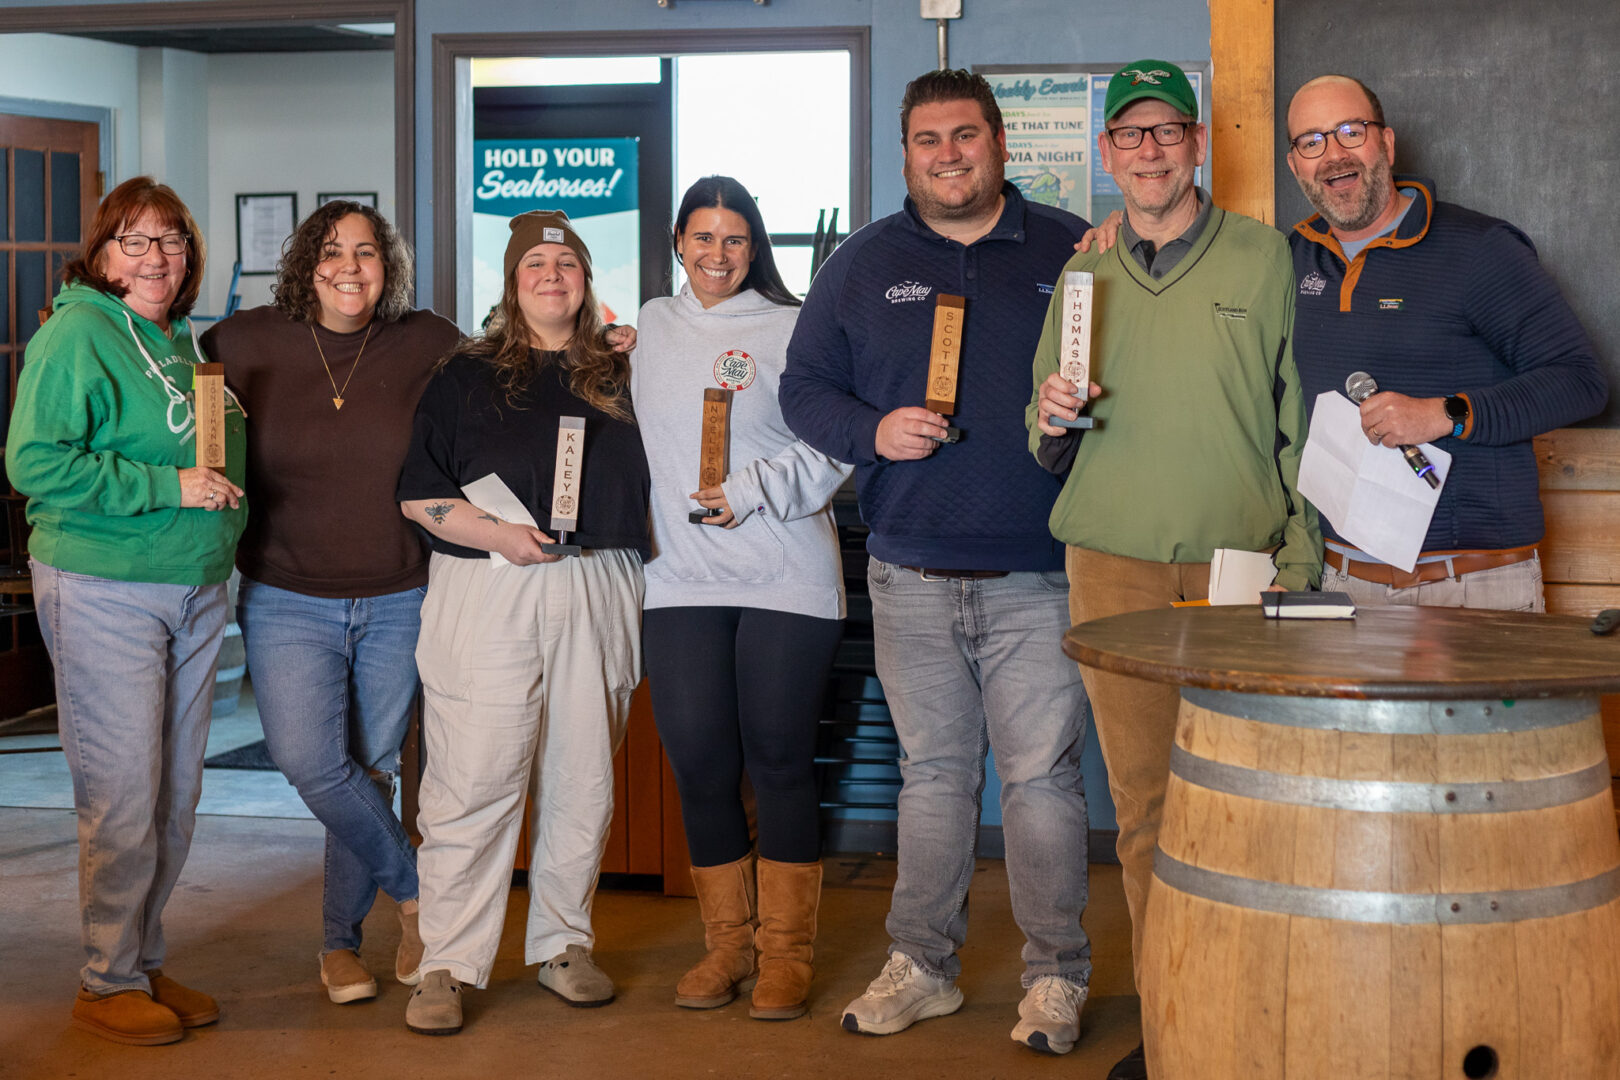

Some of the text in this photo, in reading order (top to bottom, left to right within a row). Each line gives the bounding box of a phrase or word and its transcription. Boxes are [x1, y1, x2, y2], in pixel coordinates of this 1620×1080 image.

[991, 80, 1036, 101] eekly
[1003, 121, 1084, 130] ME THAT TUNE
[484, 147, 615, 168] HOLD YOUR
[1009, 151, 1084, 162] VIA NIGHT
[476, 168, 624, 200] Seahorses!
[885, 284, 932, 300] Cape May
[1071, 289, 1082, 358] THOMAS
[941, 312, 954, 372] SCOTT
[721, 356, 749, 380] Cape May
[708, 405, 718, 465] NOELLE
[563, 432, 575, 491] KALEY
